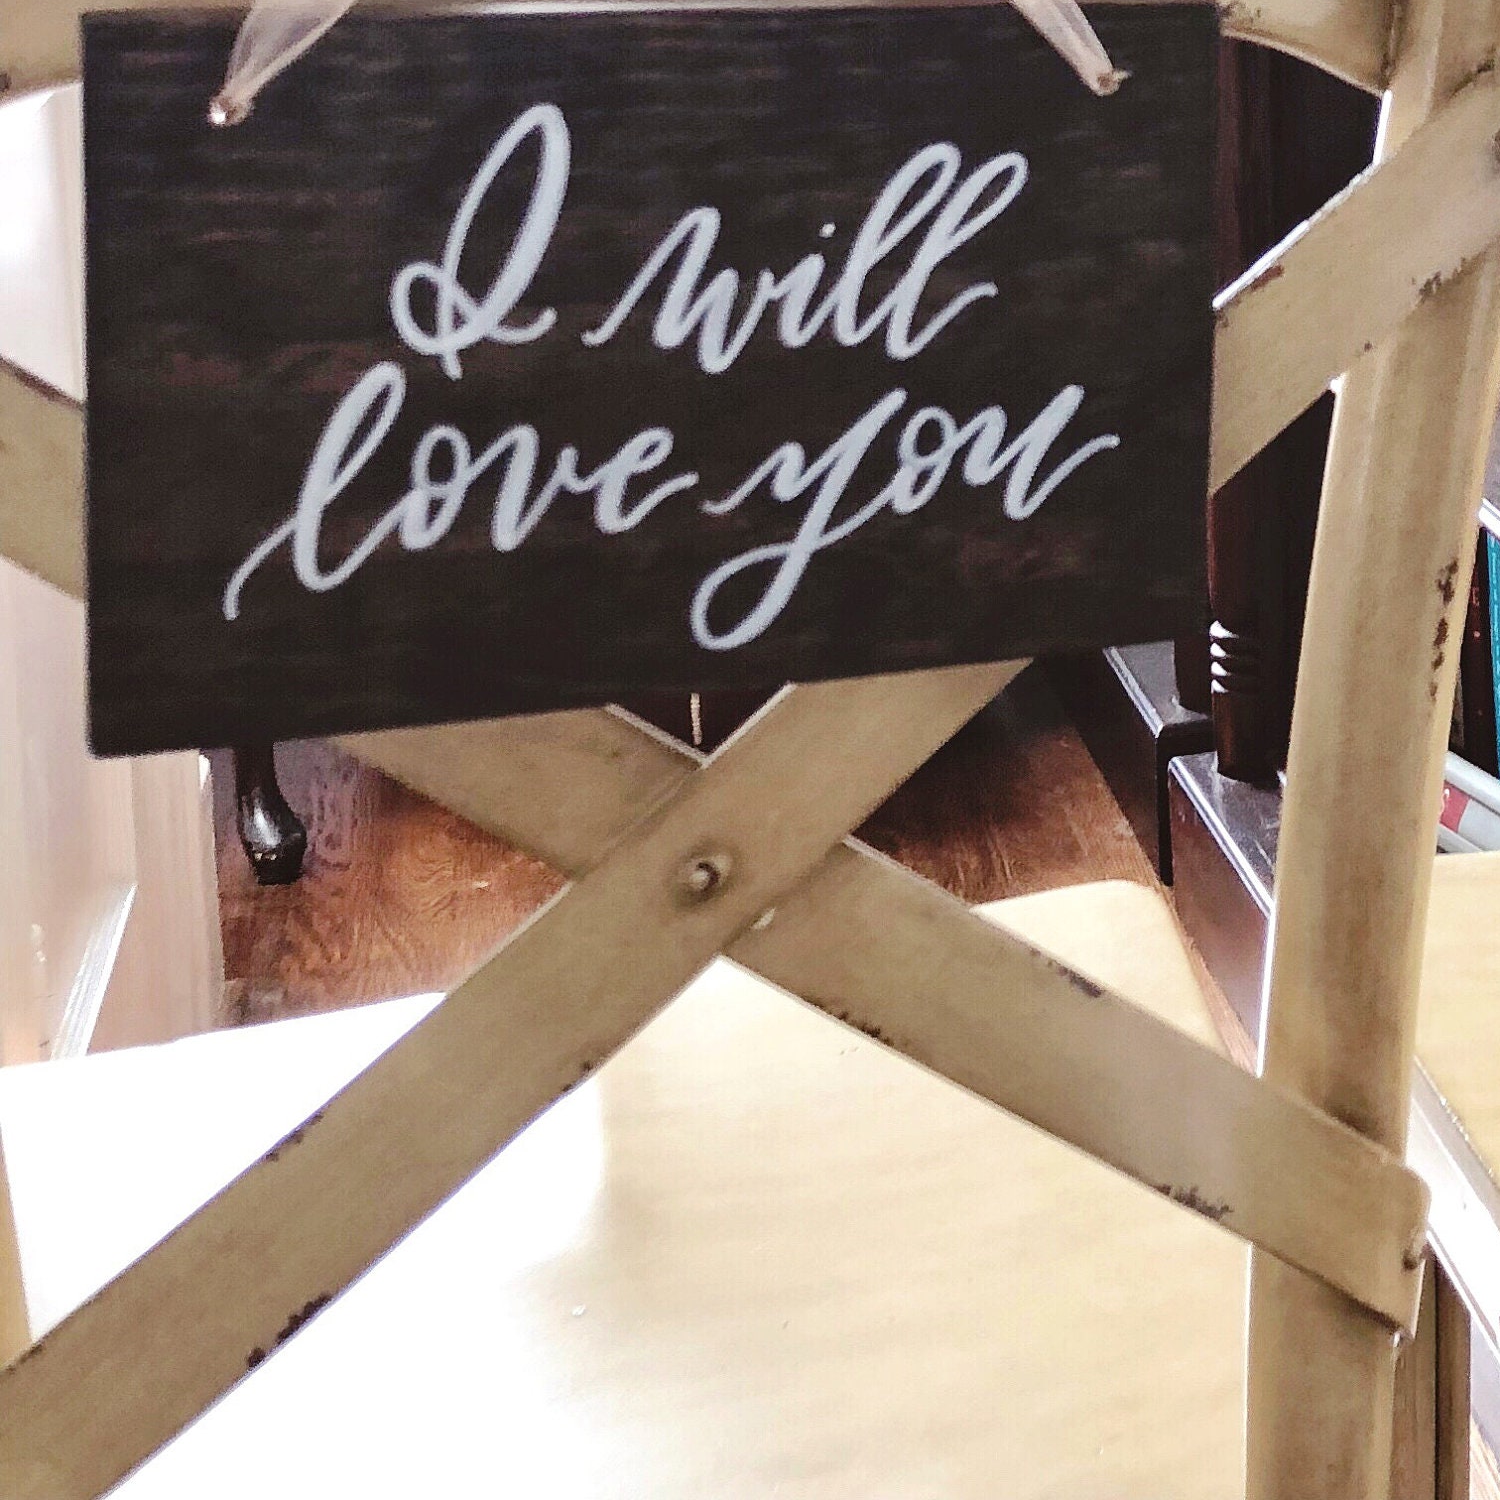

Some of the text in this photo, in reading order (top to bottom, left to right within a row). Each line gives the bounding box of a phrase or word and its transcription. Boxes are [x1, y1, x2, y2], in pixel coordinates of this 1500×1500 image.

[391, 103, 1028, 379] I will
[225, 361, 1119, 649] love you
